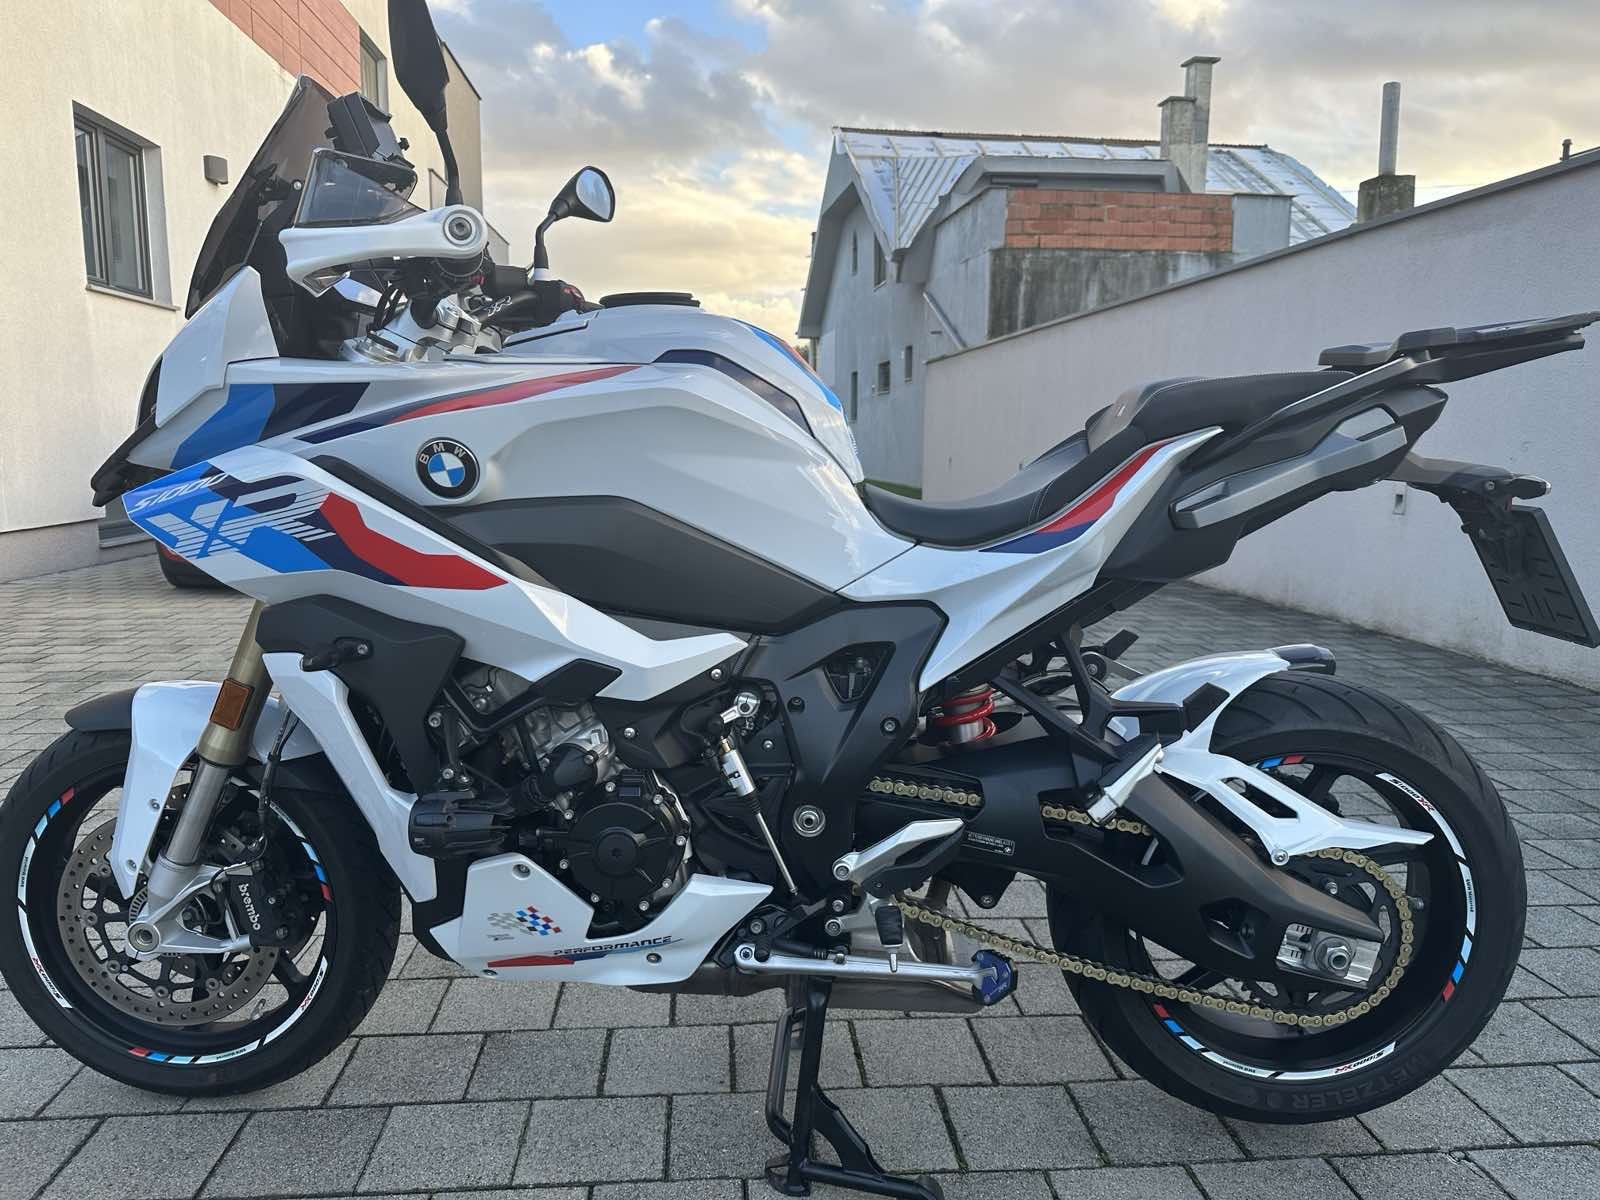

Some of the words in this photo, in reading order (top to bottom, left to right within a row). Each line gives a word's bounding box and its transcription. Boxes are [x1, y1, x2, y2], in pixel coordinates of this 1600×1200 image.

[420, 442, 466, 464] BMW
[131, 472, 230, 511] S1000
[239, 883, 261, 931] brembo
[553, 935, 672, 956] PERFORMANCE
